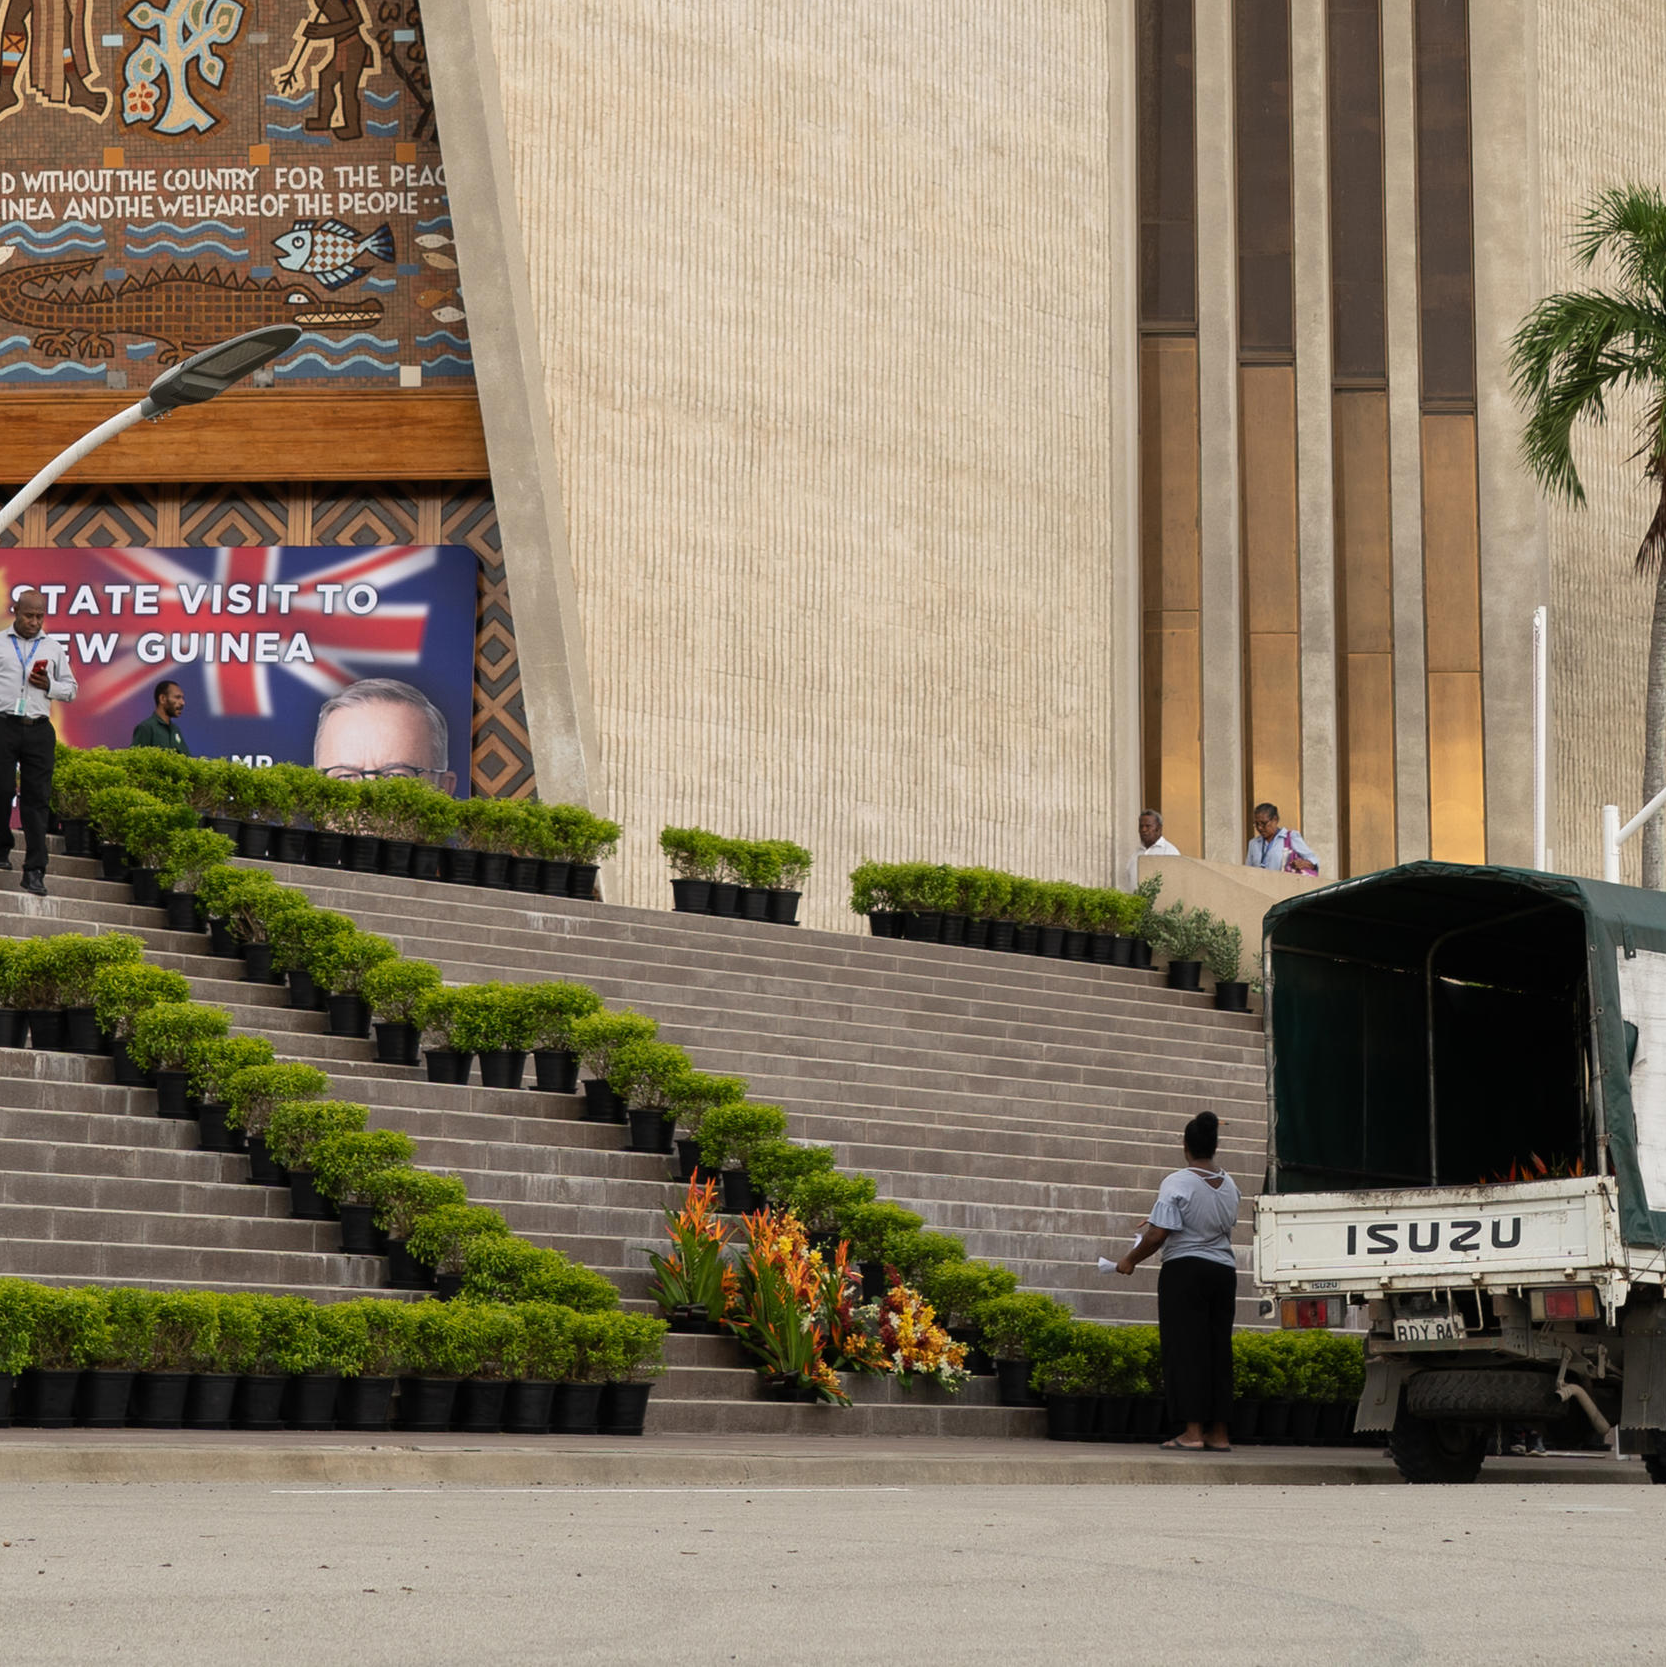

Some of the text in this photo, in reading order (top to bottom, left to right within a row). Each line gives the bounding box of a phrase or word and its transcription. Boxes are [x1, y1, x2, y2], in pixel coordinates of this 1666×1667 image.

[21, 169, 114, 193] WITHOUT
[116, 169, 157, 192] THE
[163, 167, 260, 192] COUNTRY
[275, 165, 324, 190] FOR
[334, 165, 382, 188] THE
[62, 196, 114, 220] AND
[114, 195, 155, 218] THE
[157, 192, 259, 217] WELFARE
[260, 192, 290, 217] OF
[294, 192, 333, 216] THE
[178, 584, 299, 614] VISIT
[317, 584, 378, 615] TO
[136, 633, 315, 663] GUINEA
[1347, 1217, 1521, 1256] ISUZU
[1311, 1281, 1338, 1290] ISUZU
